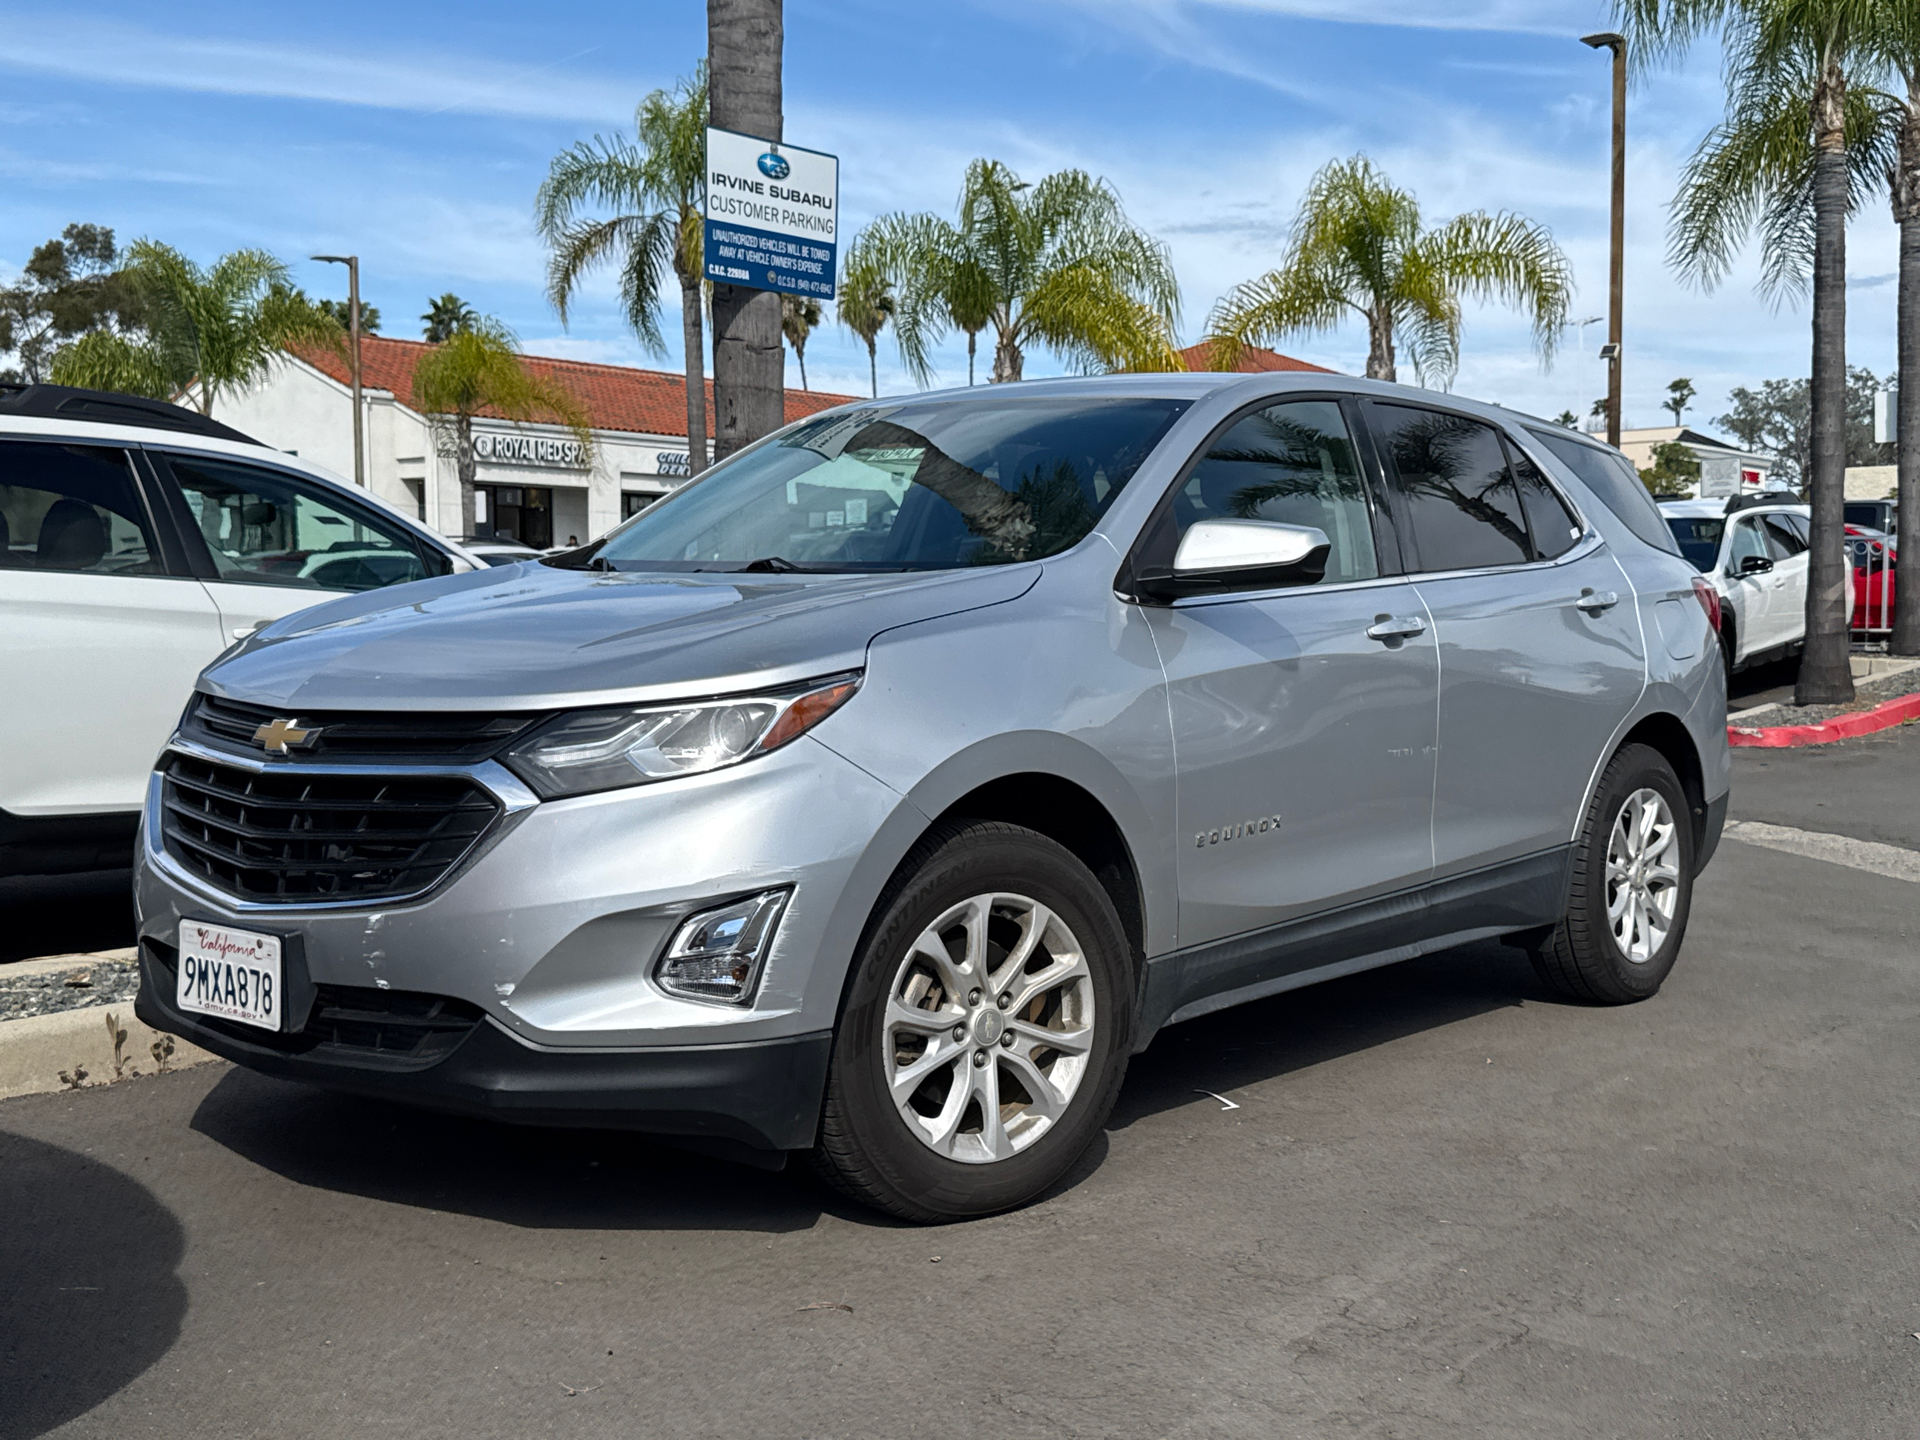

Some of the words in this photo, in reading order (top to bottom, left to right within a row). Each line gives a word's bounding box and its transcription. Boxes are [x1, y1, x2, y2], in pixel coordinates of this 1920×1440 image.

[712, 172, 764, 195] IRVINE
[769, 185, 833, 210] SUBARU
[710, 194, 779, 223] CUSTOMER
[782, 209, 834, 234] PARKING
[712, 228, 758, 248] UNAUTHORIZED
[759, 237, 787, 254] VEHICLES
[787, 243, 801, 257] WILL
[802, 245, 810, 258] BE
[810, 247, 831, 262] TOWED
[718, 245, 737, 259] AWAY
[737, 248, 745, 260] AT
[745, 250, 770, 266] VEHICLE
[494, 437, 536, 459] ROYAL
[536, 439, 562, 462] MED
[657, 452, 690, 464] CHIL
[1195, 814, 1281, 848] EQUINOX
[200, 930, 262, 960] California
[183, 956, 273, 1015] 9MXA878
[204, 1002, 257, 1019] dmv.ca.gov
